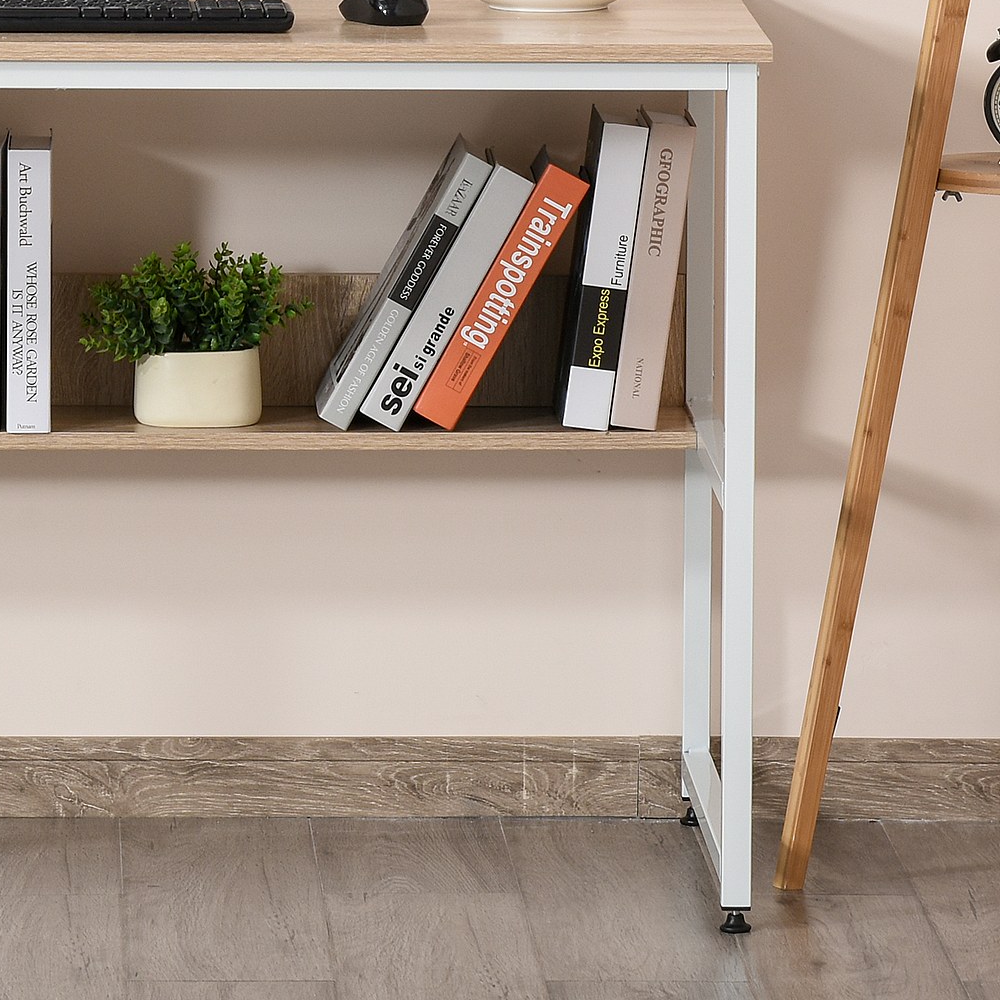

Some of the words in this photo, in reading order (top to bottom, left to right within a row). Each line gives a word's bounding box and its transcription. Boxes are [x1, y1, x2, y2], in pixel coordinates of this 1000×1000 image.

[19, 162, 32, 183] Art
[19, 186, 33, 247] Buchwald
[421, 223, 448, 261] FOREVER
[610, 234, 629, 286] Furniture
[26, 262, 38, 310] WHOSE
[400, 260, 427, 301] GODDESS
[460, 196, 573, 350] Trainspotting
[12, 289, 23, 300] IS
[12, 304, 23, 317] IT
[592, 288, 611, 336] Express
[26, 314, 38, 345] ROSE
[375, 309, 399, 345] GOLDEN
[12, 320, 23, 376] ANYWAY?
[364, 344, 379, 363] AGE
[380, 362, 420, 416] sei
[413, 354, 427, 371] si
[422, 306, 455, 357] grande
[588, 338, 605, 368] Expo
[26, 349, 38, 403] GARDEN
[358, 363, 369, 377] OF
[631, 357, 645, 400] NATIONAL
[336, 376, 362, 414] FASHION
